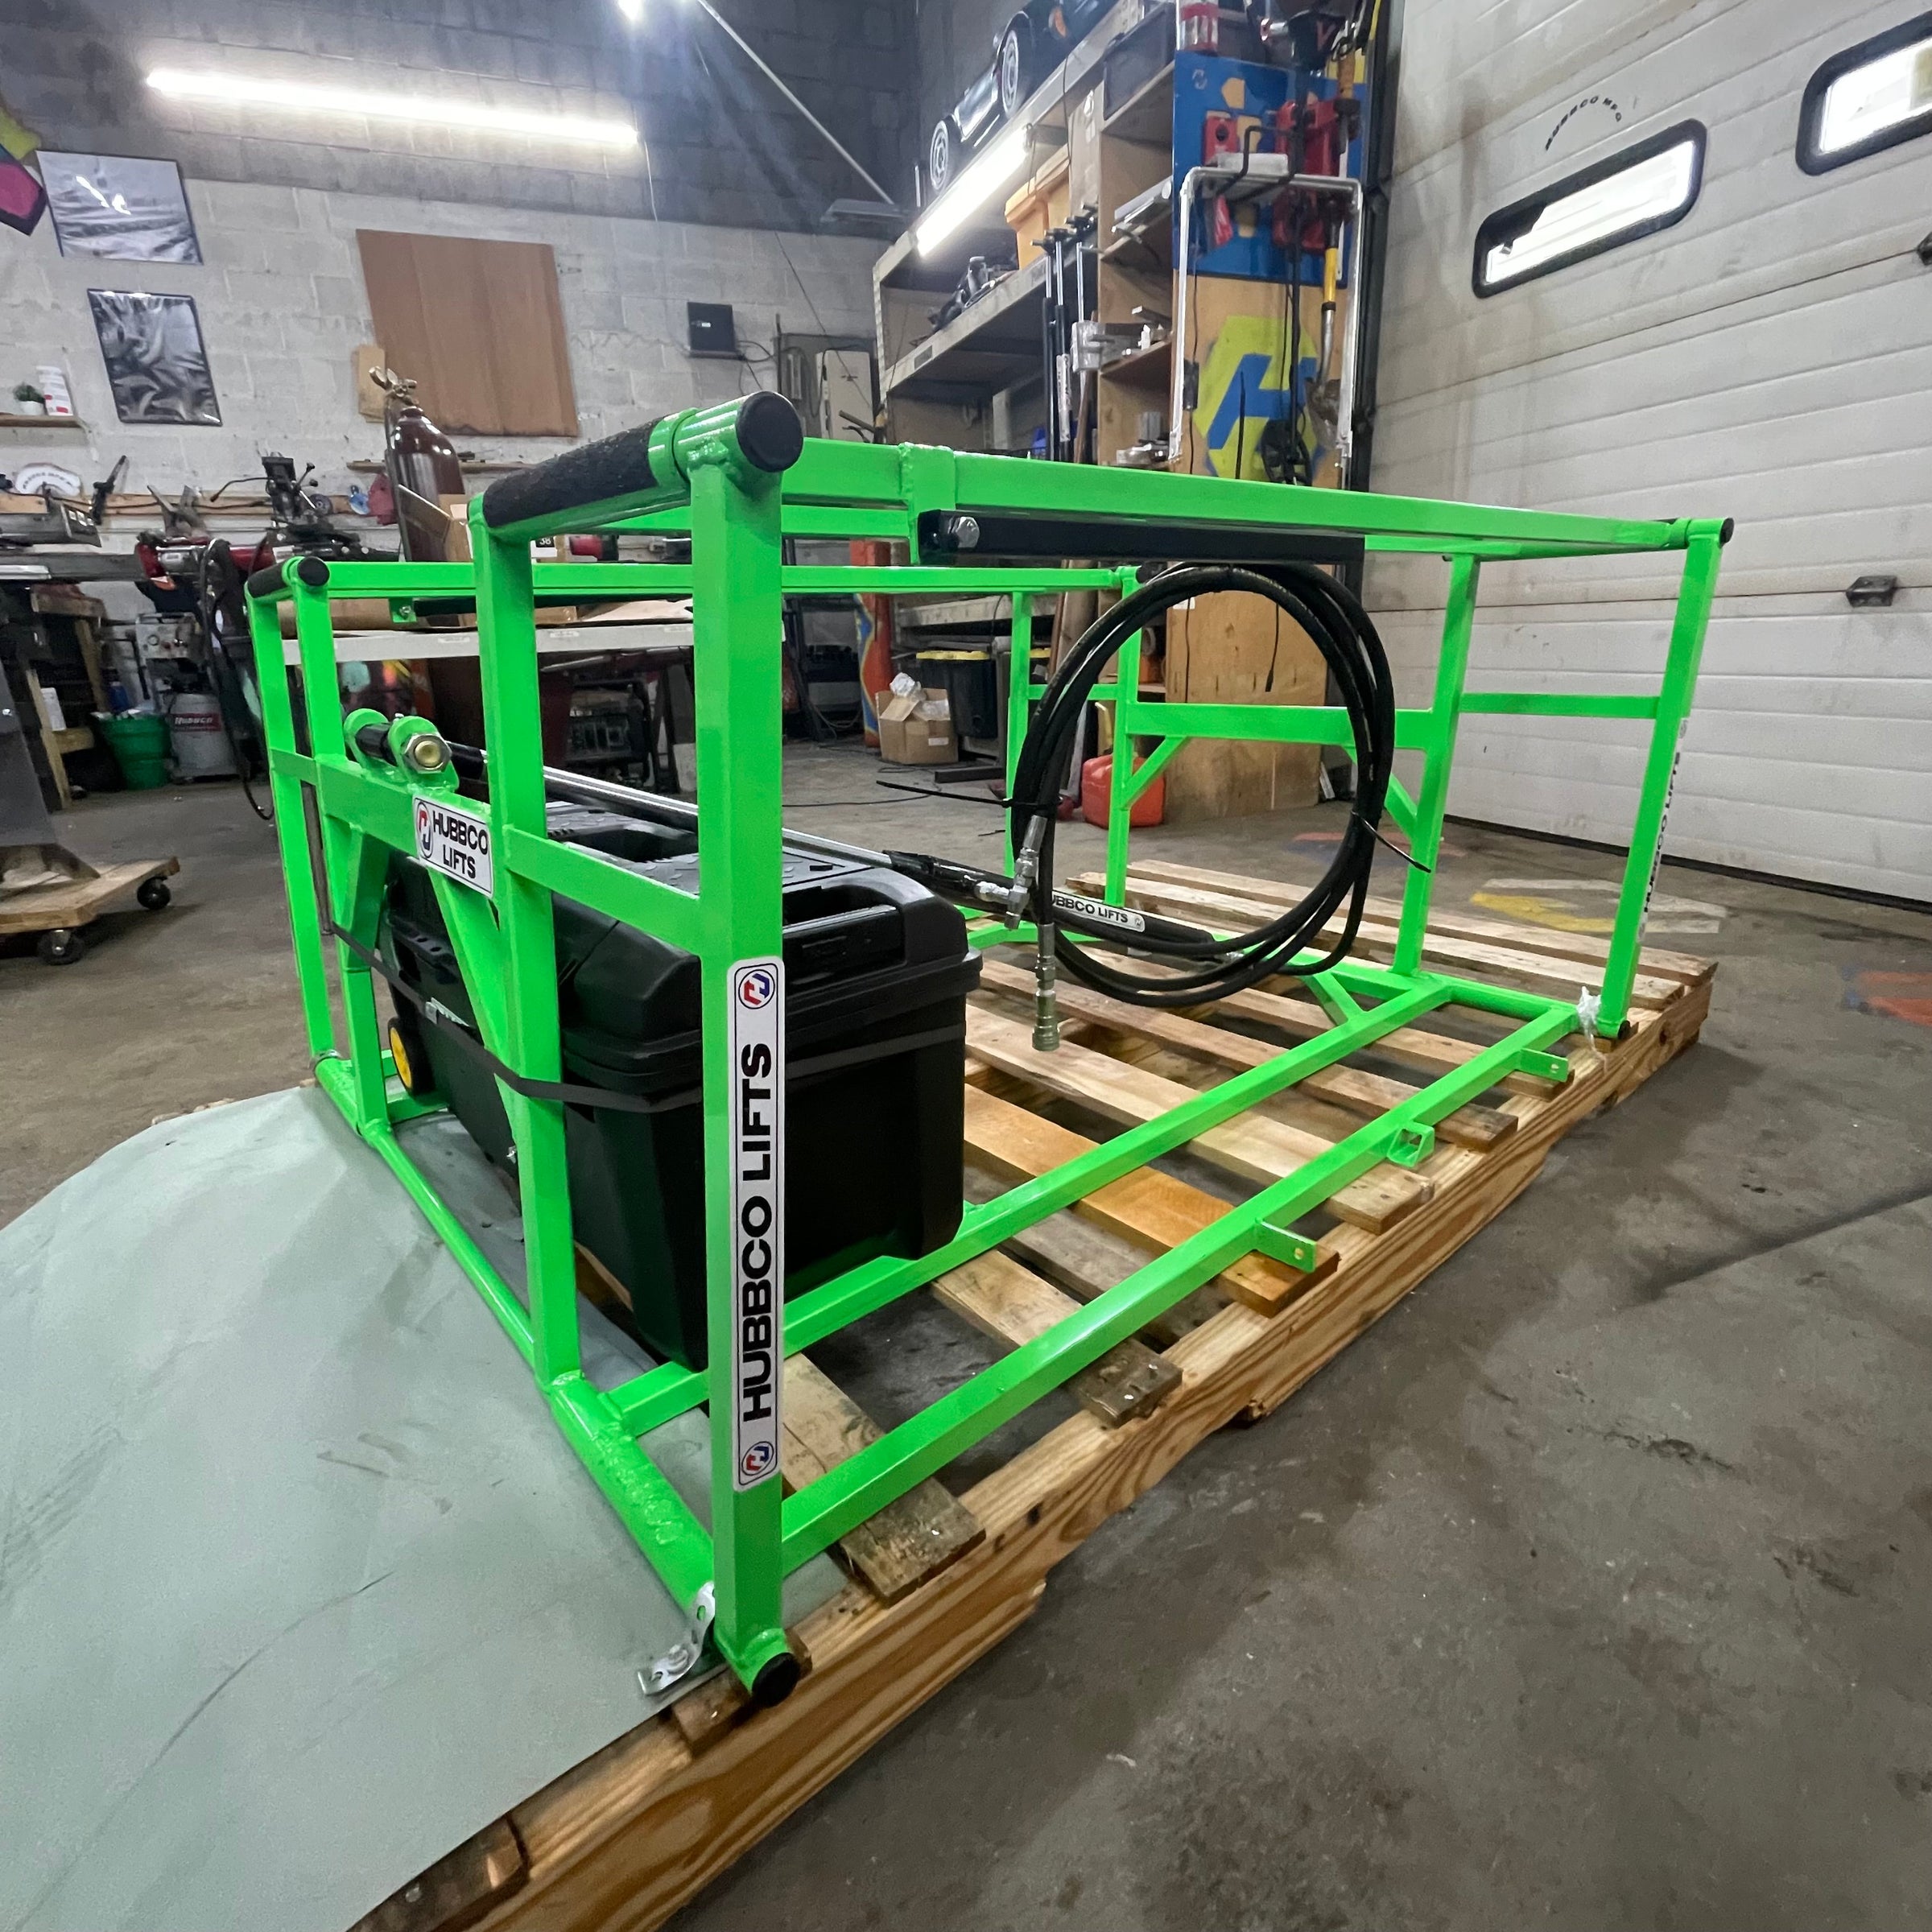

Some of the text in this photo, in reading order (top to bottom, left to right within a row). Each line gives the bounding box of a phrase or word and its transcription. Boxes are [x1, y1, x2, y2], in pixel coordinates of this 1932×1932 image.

[432, 810, 488, 855] HUBBCO
[443, 844, 476, 879] LIFTS
[1098, 906, 1129, 923] LIFTS
[741, 1043, 772, 1422] HUBBCO LIFTS
